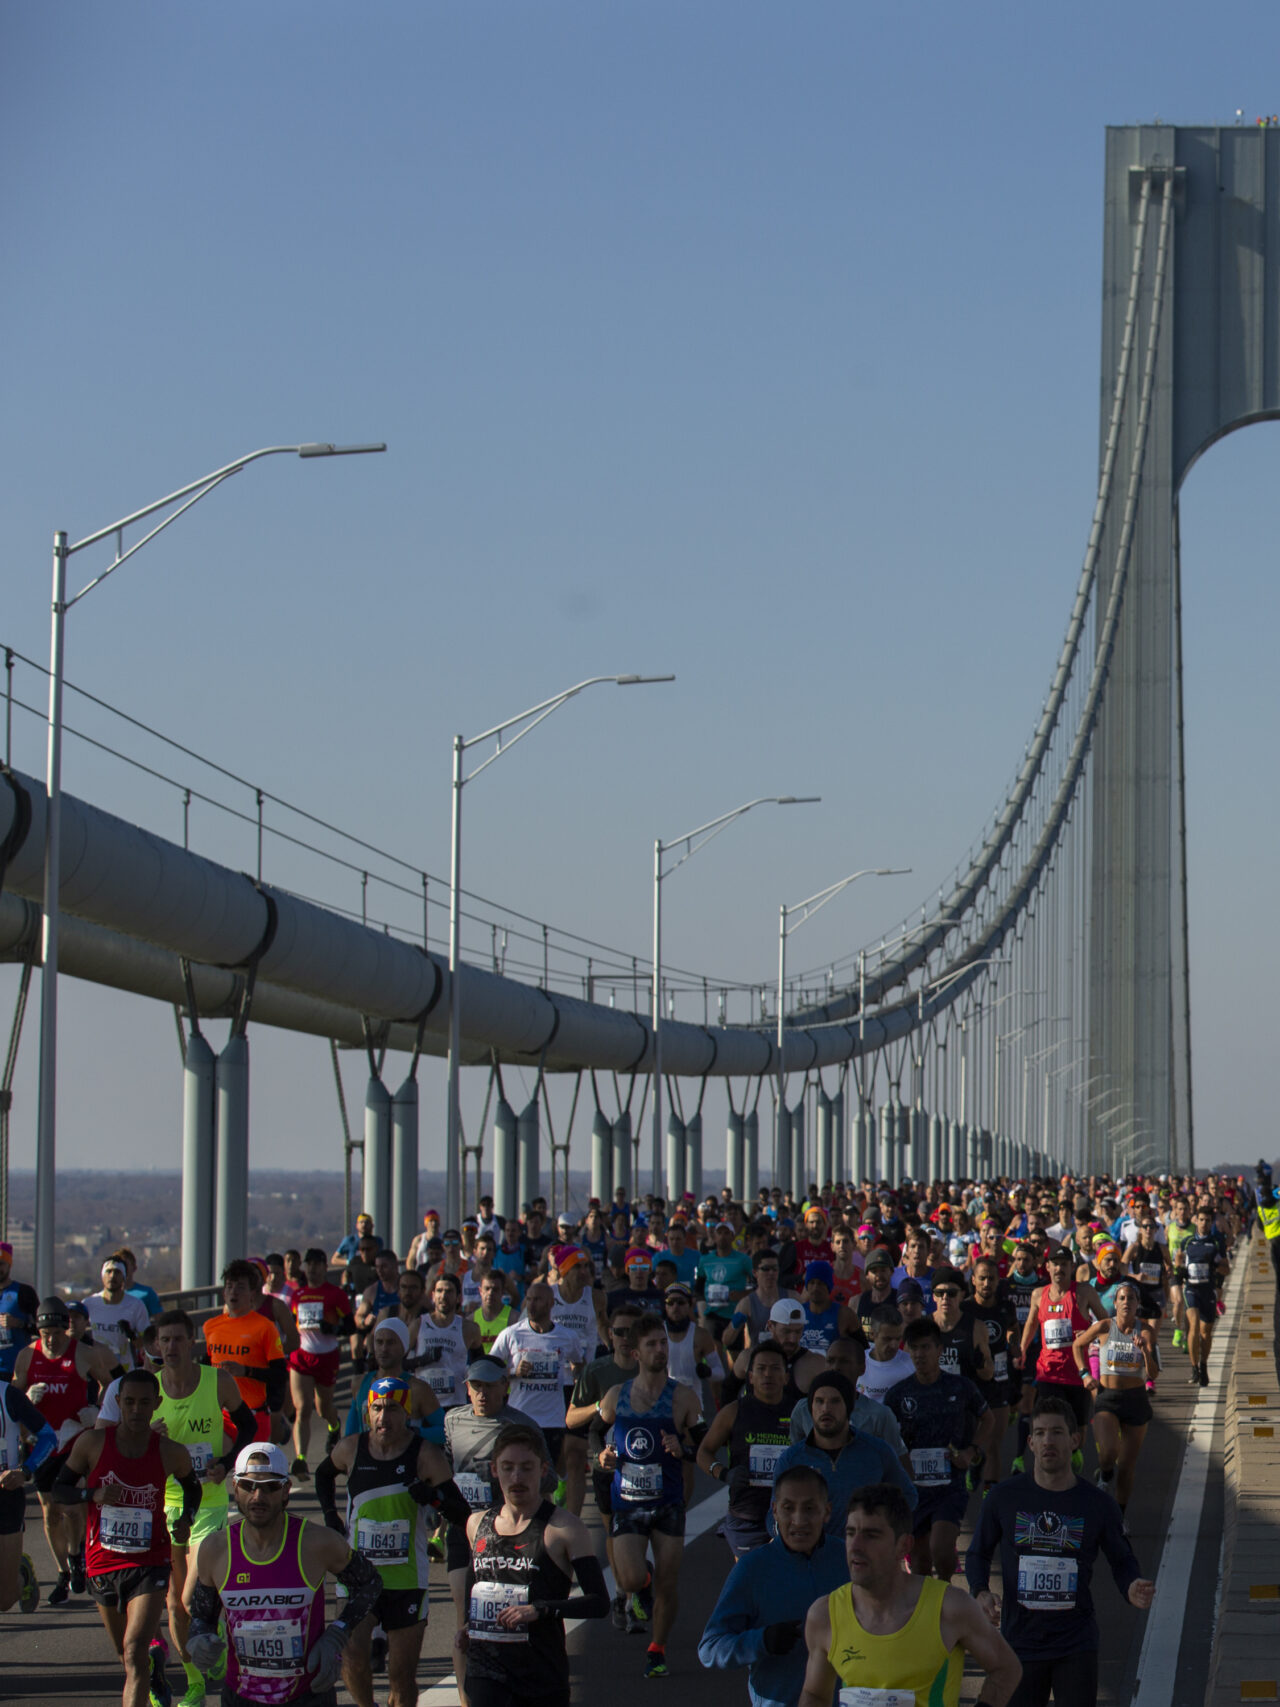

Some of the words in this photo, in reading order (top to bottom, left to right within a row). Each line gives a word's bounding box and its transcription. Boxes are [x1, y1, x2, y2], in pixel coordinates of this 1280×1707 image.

[519, 1382, 559, 1392] FRANCE
[762, 1457, 778, 1472] 137
[920, 1459, 939, 1473] 1162
[111, 1521, 139, 1537] 4478
[371, 1533, 396, 1550] 1643
[472, 1556, 541, 1573] ARTBREAK
[1033, 1572, 1062, 1591] 1356
[252, 1639, 285, 1658] 1459
